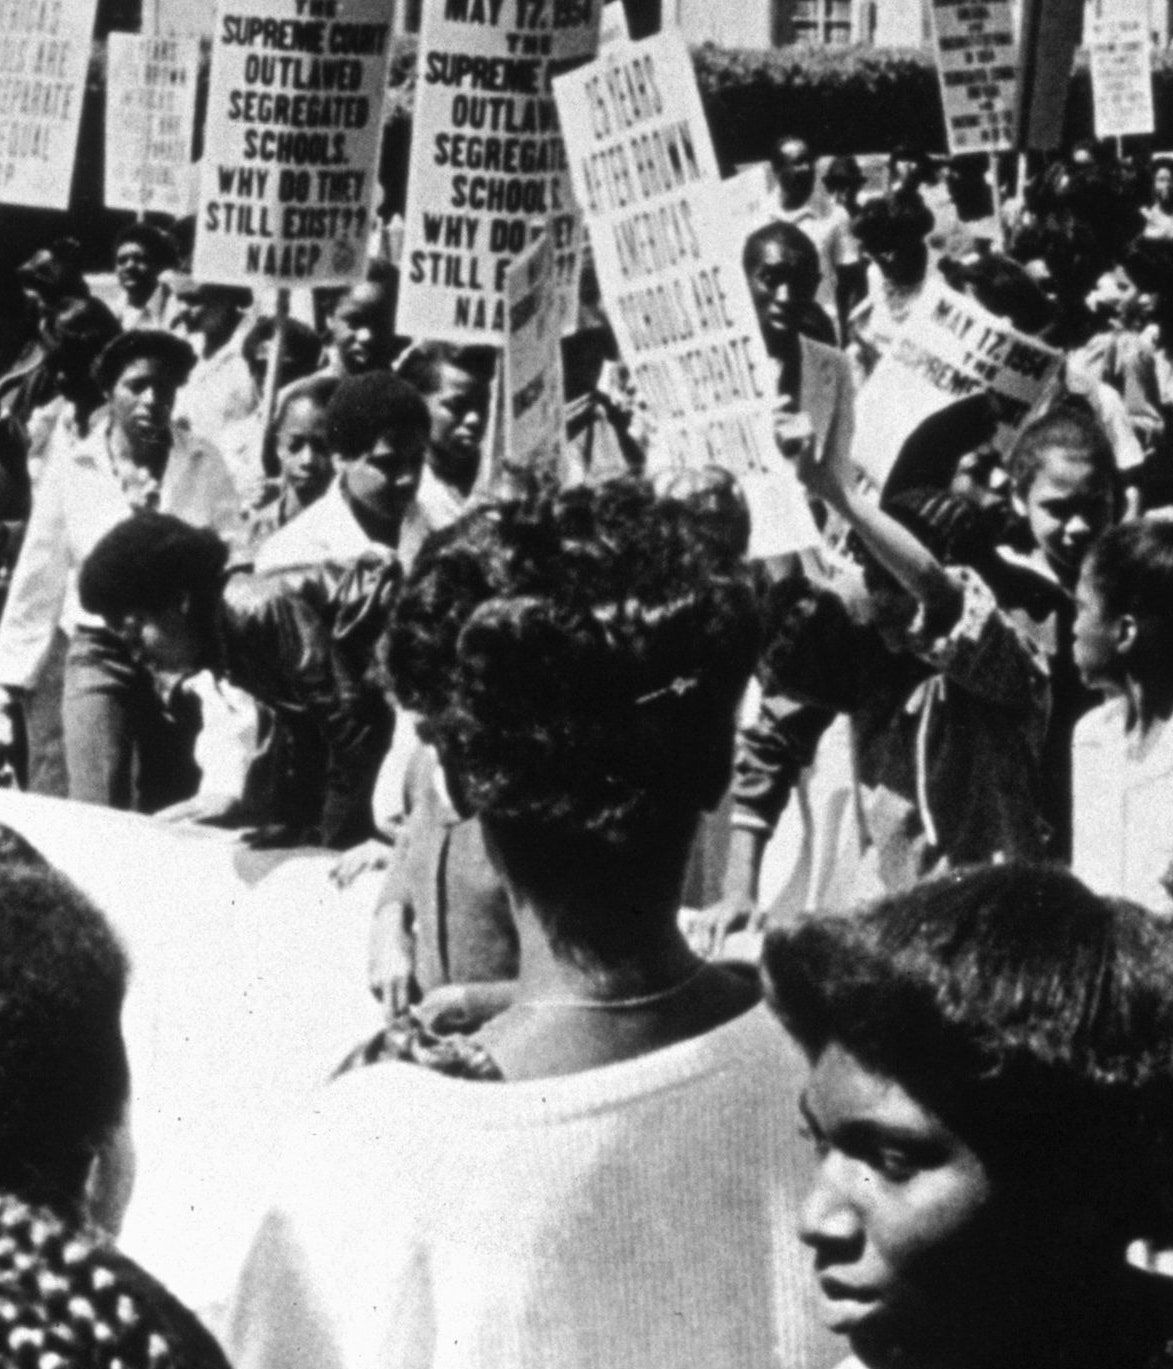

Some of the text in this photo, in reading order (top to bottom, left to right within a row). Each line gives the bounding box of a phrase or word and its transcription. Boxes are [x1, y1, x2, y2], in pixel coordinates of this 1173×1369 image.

[222, 13, 328, 54] SUPREME
[505, 32, 552, 56] THE
[244, 52, 363, 91] OUTLAWED
[425, 50, 542, 95] SUPREME
[604, 53, 664, 130] YEARS
[228, 88, 370, 130] SEGREGATED
[218, 165, 366, 203] WHY DO THEY
[581, 118, 702, 215] AFTER BROWN
[205, 200, 273, 238] STILL
[422, 212, 480, 251] WHY
[489, 217, 527, 255] DO
[246, 242, 323, 278] NAACP
[409, 250, 483, 290] STILL
[454, 295, 505, 332] NAA
[690, 265, 735, 329] ARE
